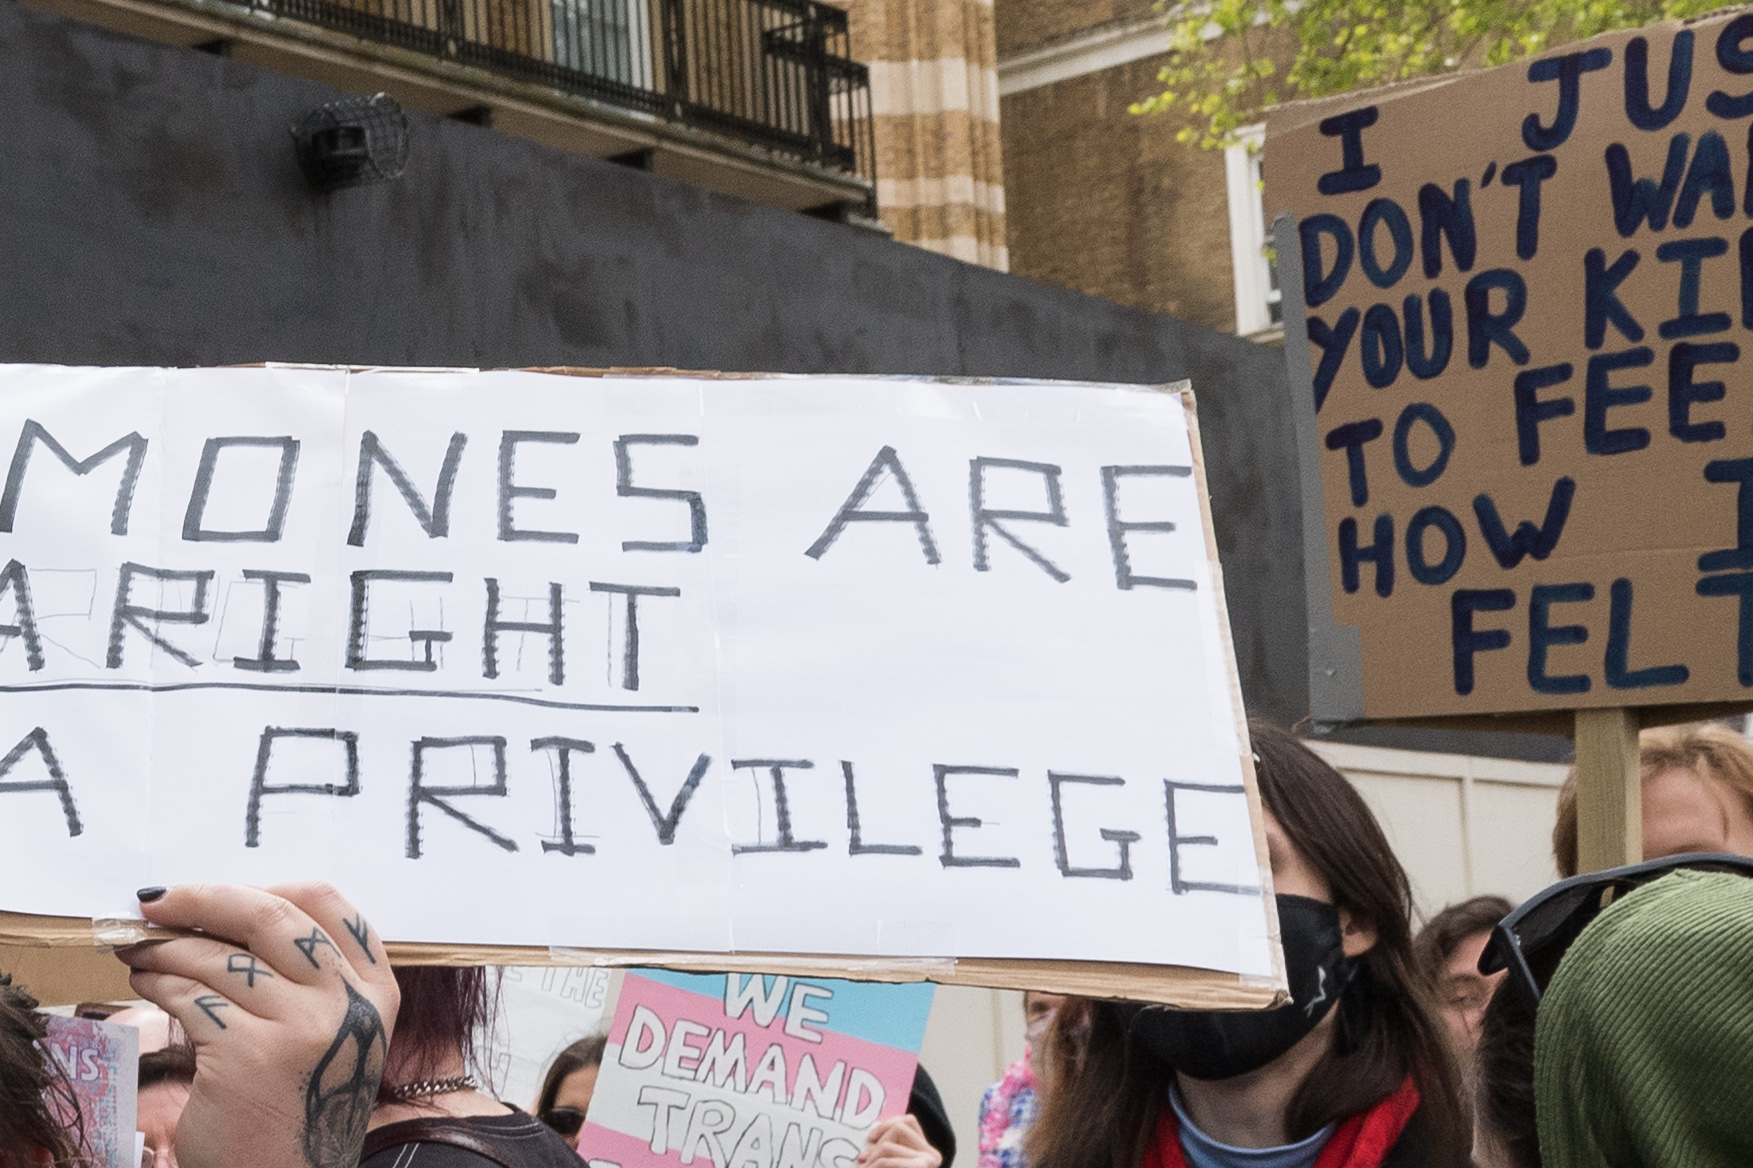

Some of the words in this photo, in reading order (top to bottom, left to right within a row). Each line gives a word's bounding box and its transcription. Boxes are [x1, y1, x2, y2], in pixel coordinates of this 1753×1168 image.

[1318, 106, 1382, 196] I
[1299, 154, 1558, 308] DON'T
[1604, 130, 1753, 238] WA
[1307, 268, 1530, 416] YOUR
[1584, 226, 1753, 350] KI
[804, 446, 1198, 591] ARE
[1325, 403, 1456, 507] TO
[1339, 476, 1576, 598] HOW
[105, 560, 681, 692] RIGHT
[245, 726, 1261, 895] PRIVILEGE
[618, 1004, 886, 1130] DEMAND
[724, 973, 834, 1044] WE
